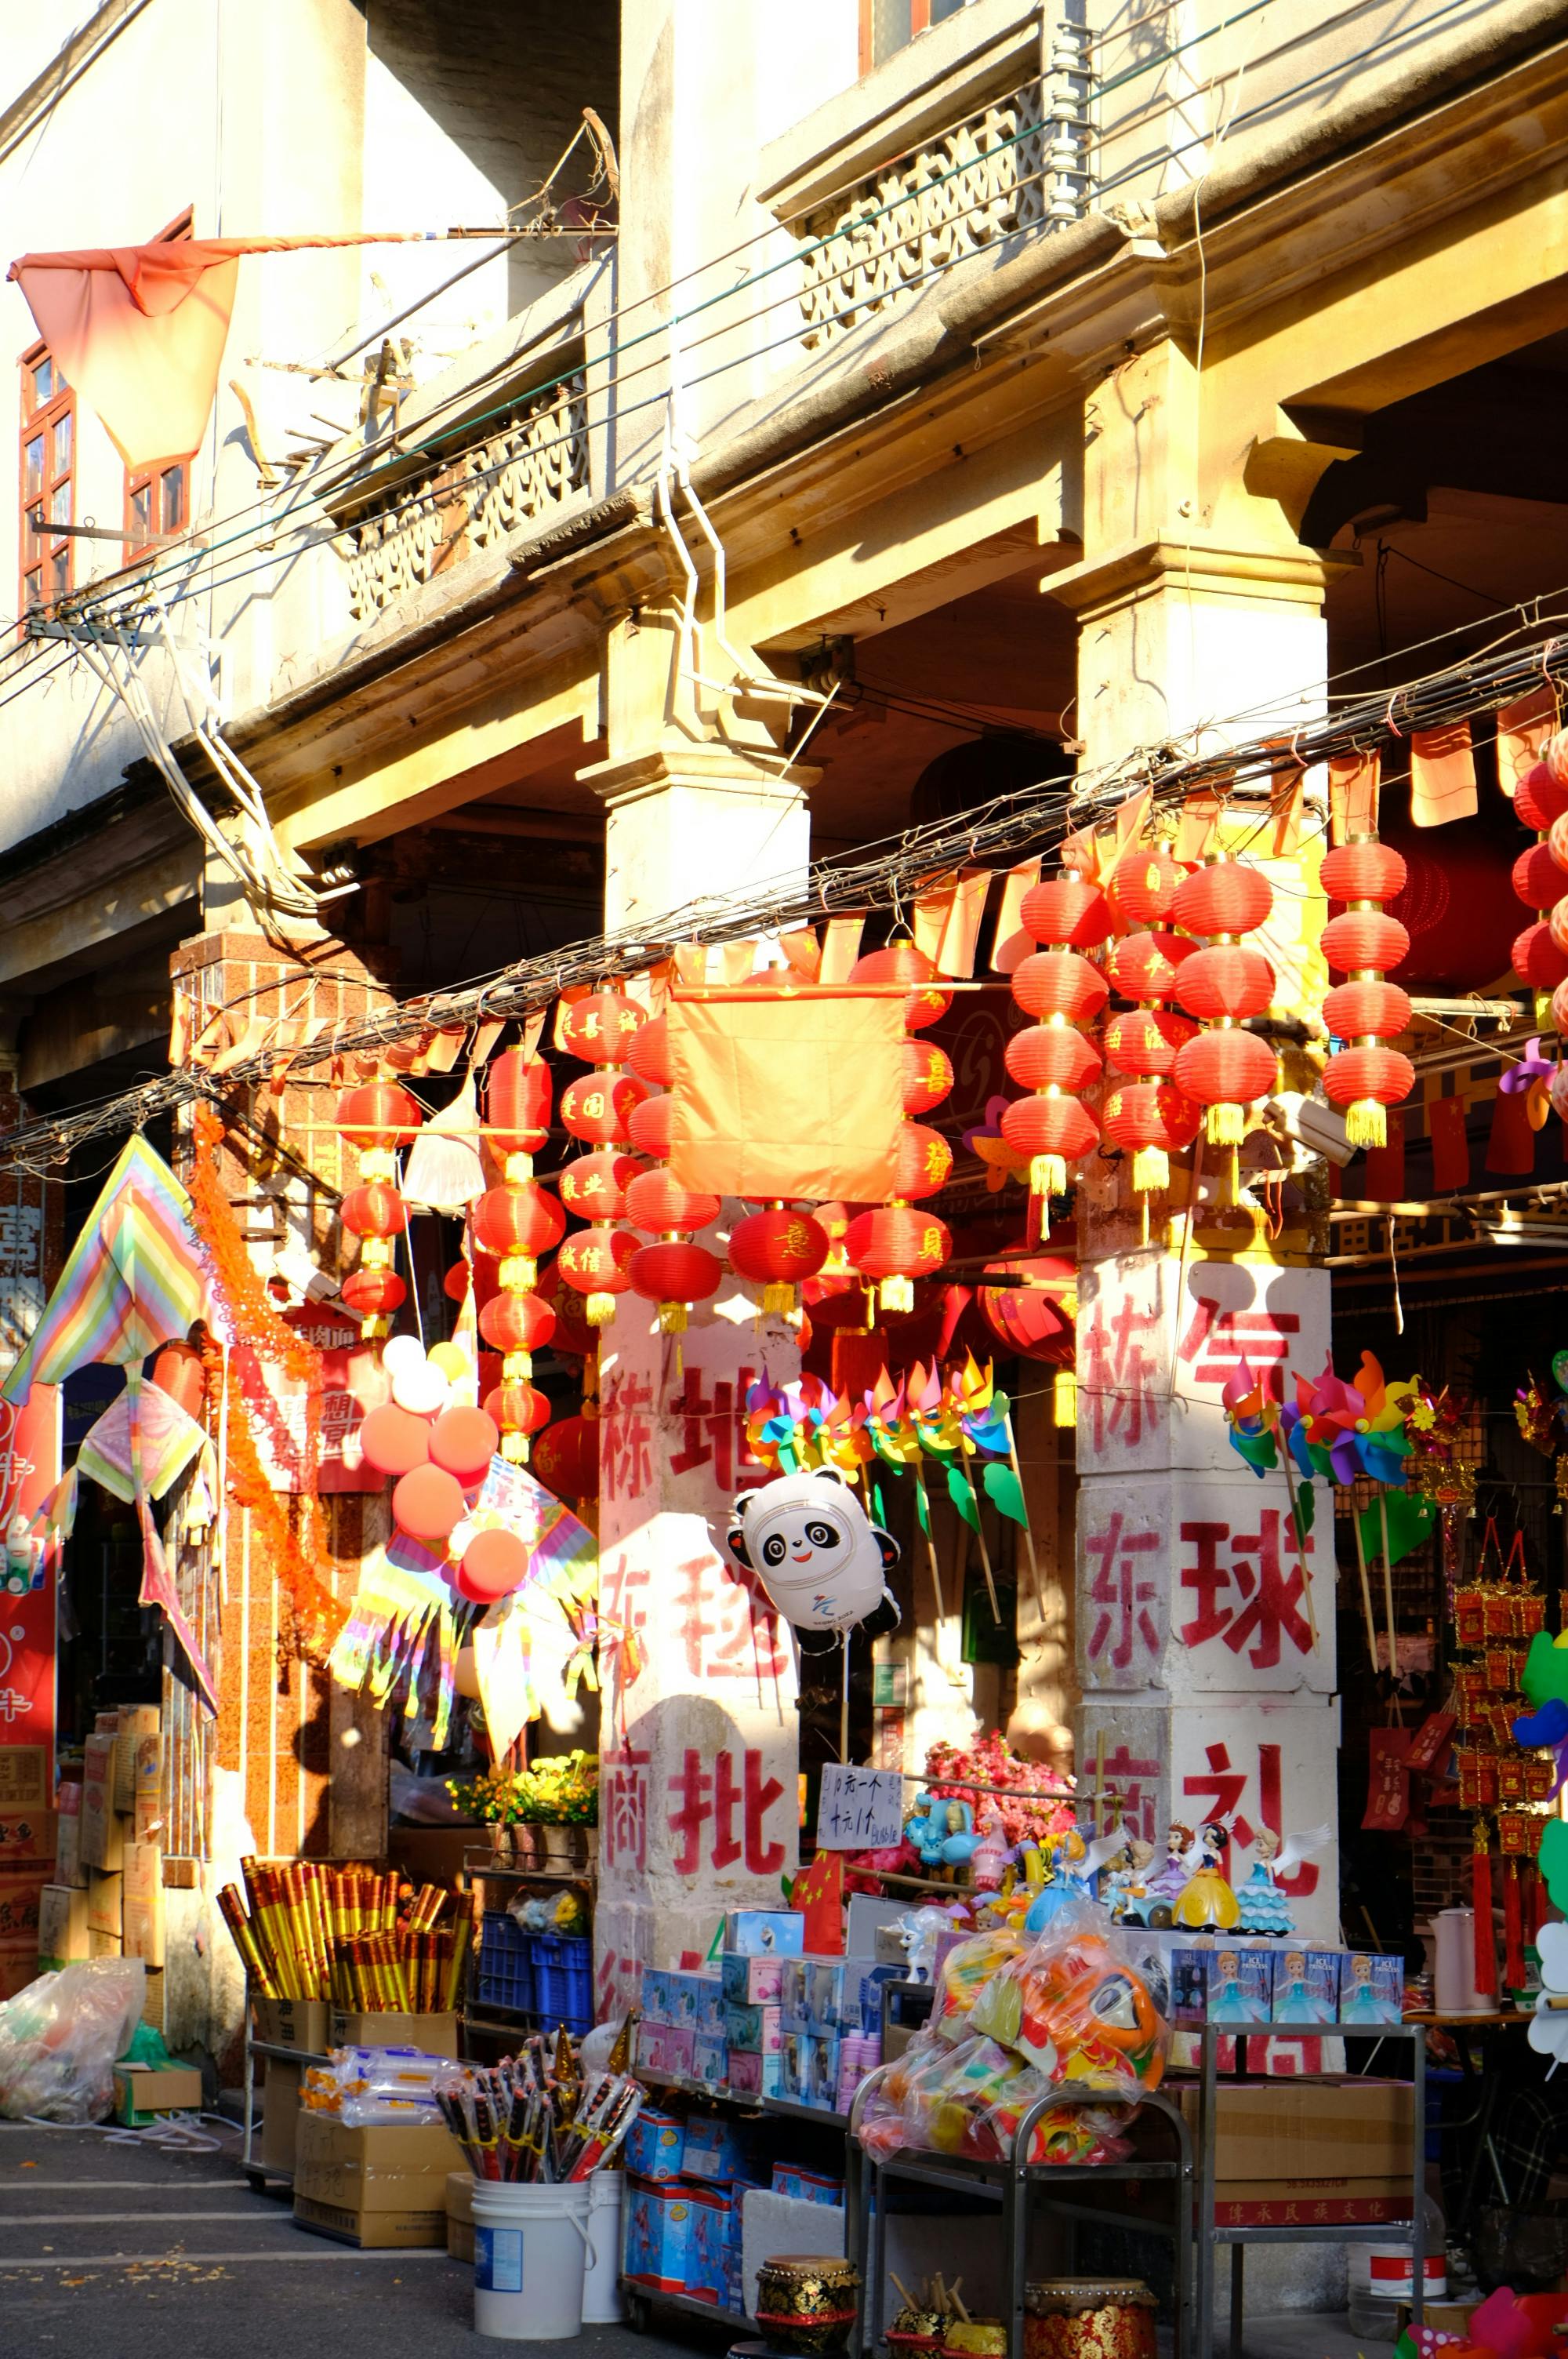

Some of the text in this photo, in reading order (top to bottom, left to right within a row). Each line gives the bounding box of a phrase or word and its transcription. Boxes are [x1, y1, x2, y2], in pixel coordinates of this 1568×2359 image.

[562, 1245, 604, 1272] 诚信
[666, 1366, 789, 1970] 地毯批
[1228, 2201, 1385, 2223] 傳承民族文化
